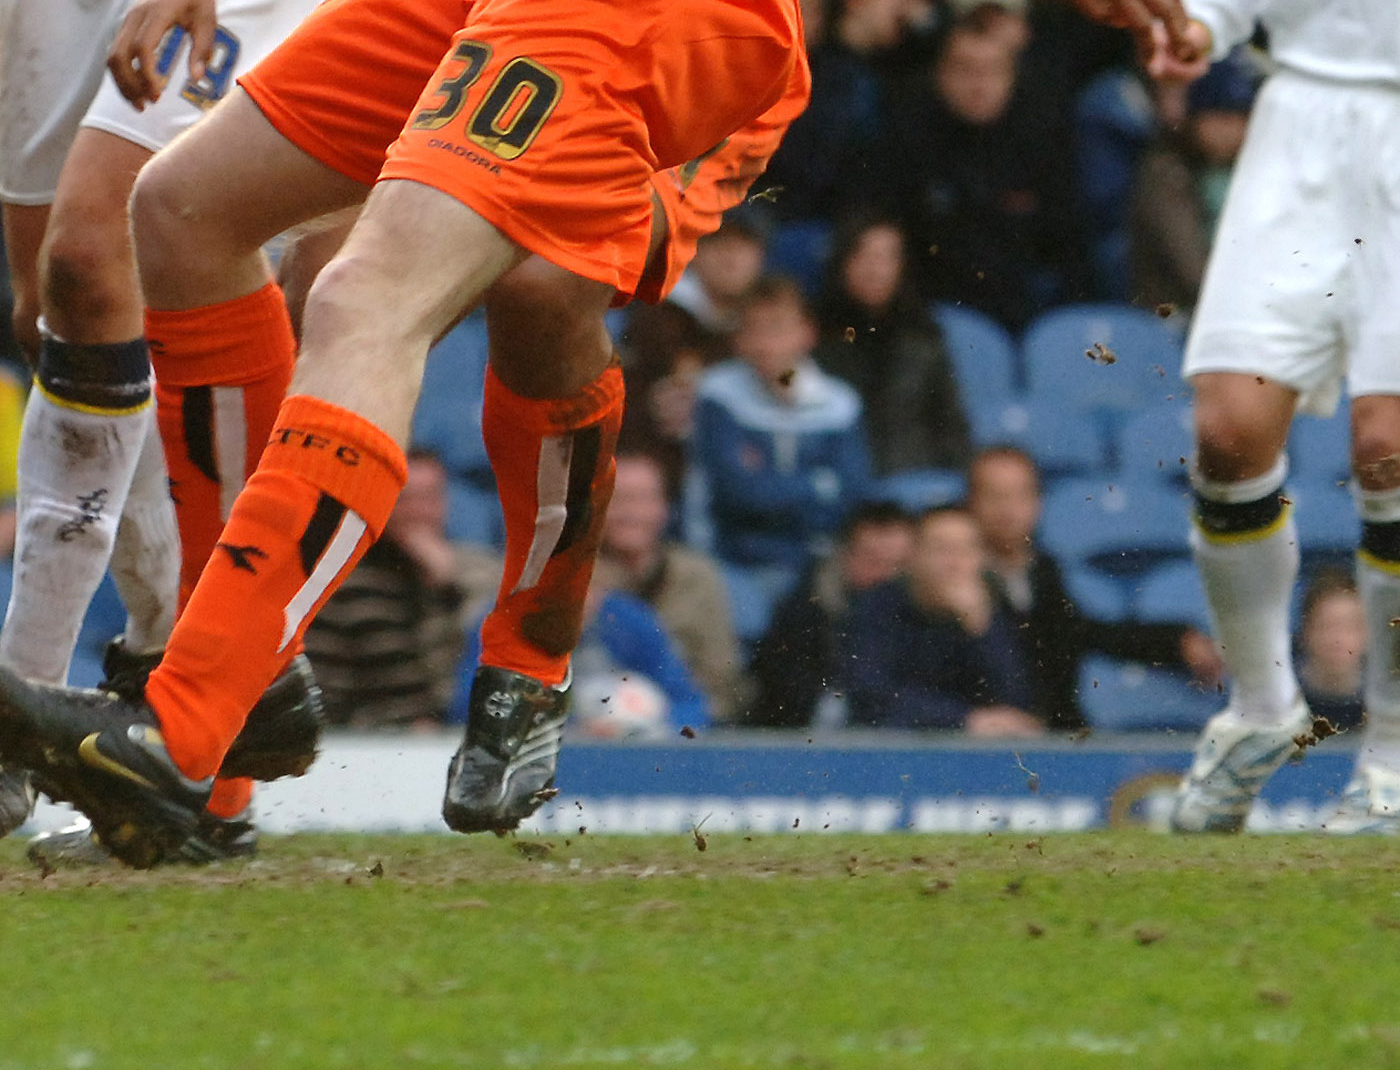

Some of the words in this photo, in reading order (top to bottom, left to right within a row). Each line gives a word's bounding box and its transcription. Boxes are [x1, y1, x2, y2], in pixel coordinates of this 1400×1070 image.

[410, 38, 565, 162] 30
[427, 137, 502, 176] DIADORA
[267, 428, 360, 466] TFC
